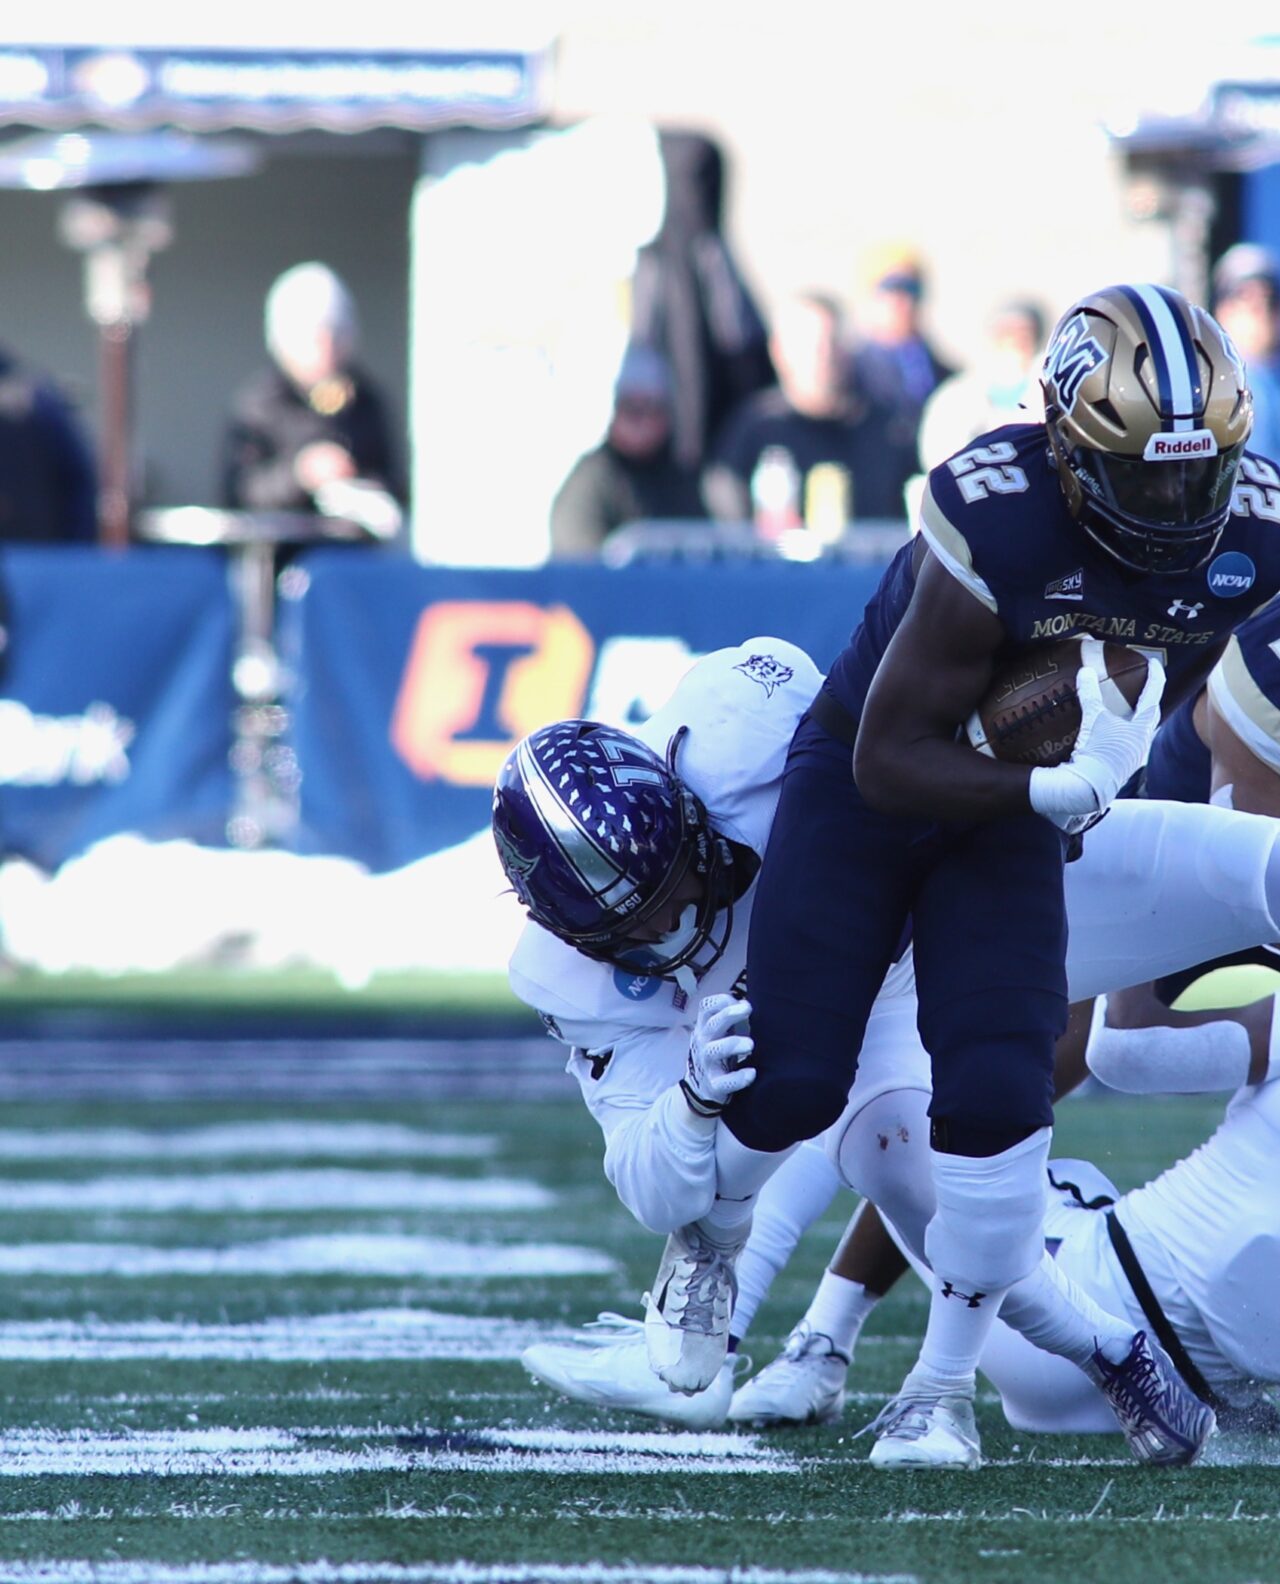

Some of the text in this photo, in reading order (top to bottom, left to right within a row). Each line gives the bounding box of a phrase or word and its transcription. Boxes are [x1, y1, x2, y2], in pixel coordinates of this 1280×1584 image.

[1155, 438, 1210, 454] Riddell
[946, 441, 1030, 504] 22
[1212, 574, 1251, 589] NCAA
[1031, 613, 1214, 644] MONTANA STATE
[597, 737, 664, 787] 17
[614, 893, 642, 916] WSU
[628, 960, 657, 997] NCA
